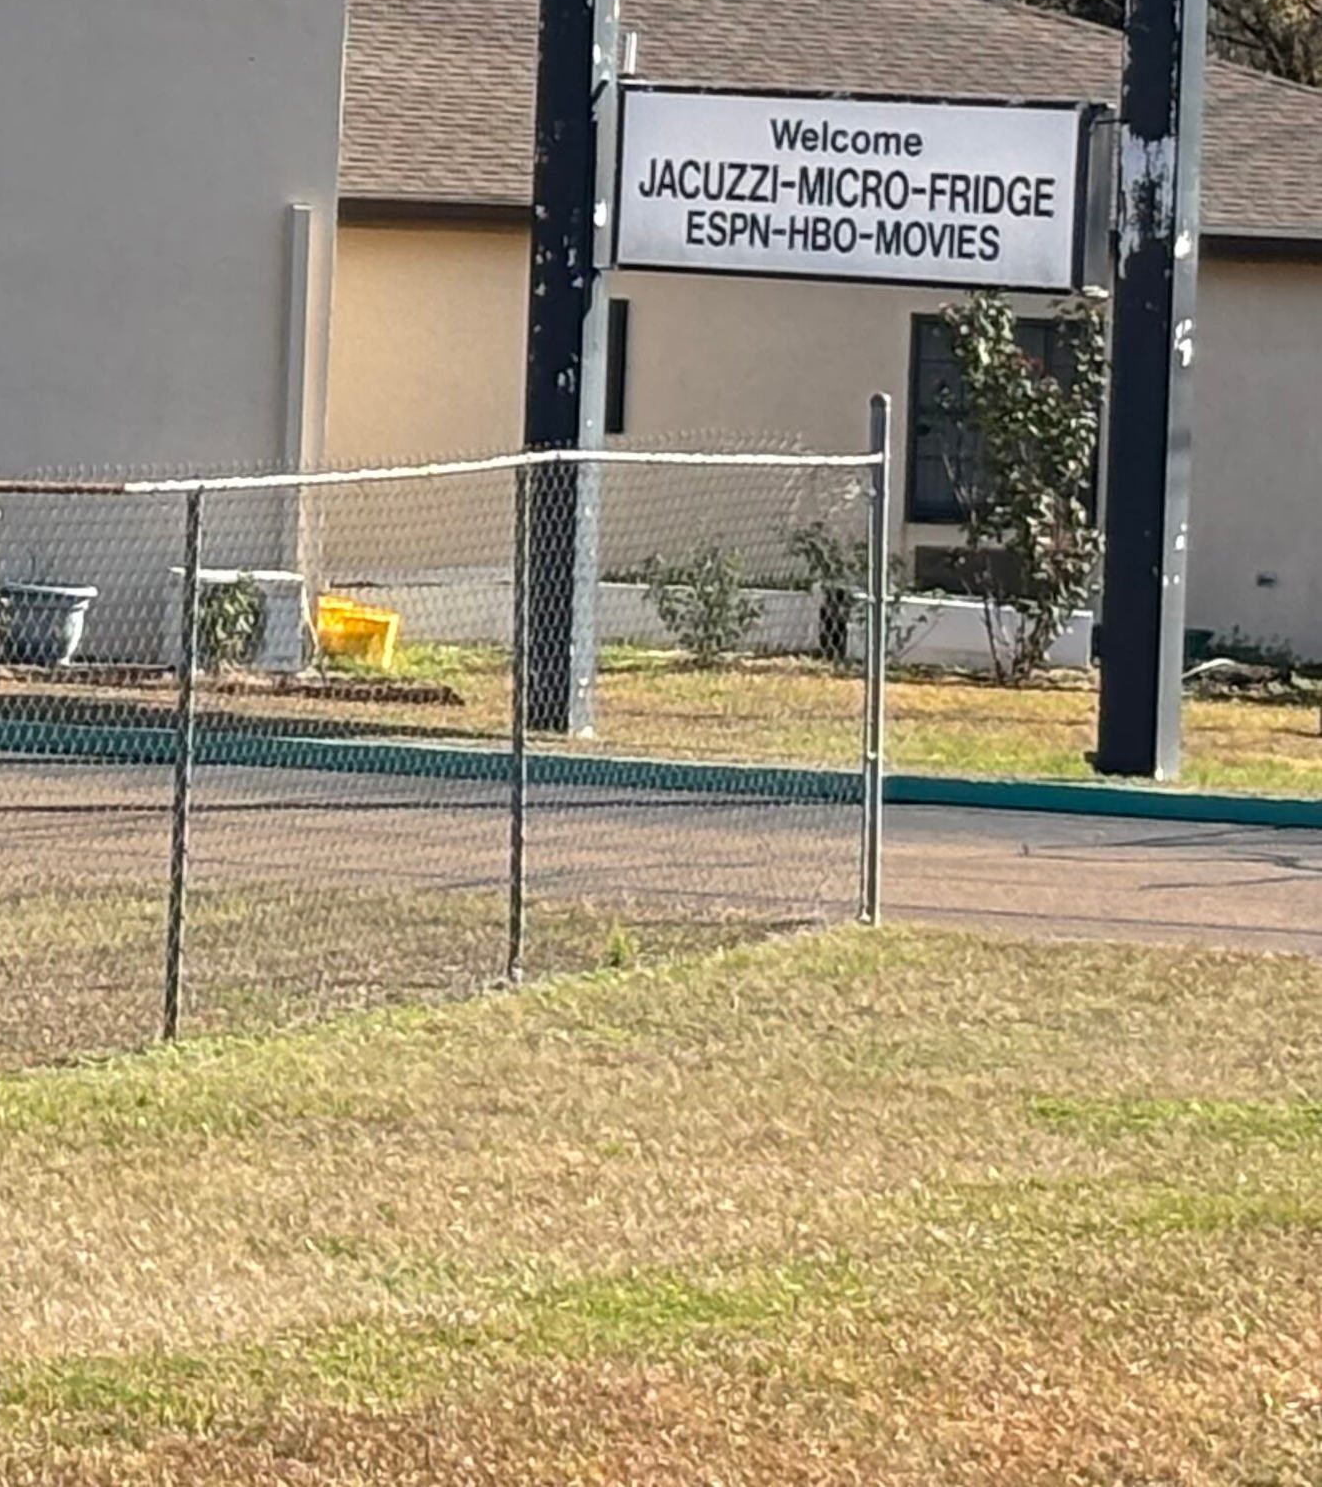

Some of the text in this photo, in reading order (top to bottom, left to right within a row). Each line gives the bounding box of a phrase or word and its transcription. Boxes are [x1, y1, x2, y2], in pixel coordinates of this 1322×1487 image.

[770, 118, 924, 158] Welcome
[638, 158, 1056, 219] JACUZZI-MICRO-FRIDGE
[685, 210, 1002, 262] ESPN-HBO-MOVIES
